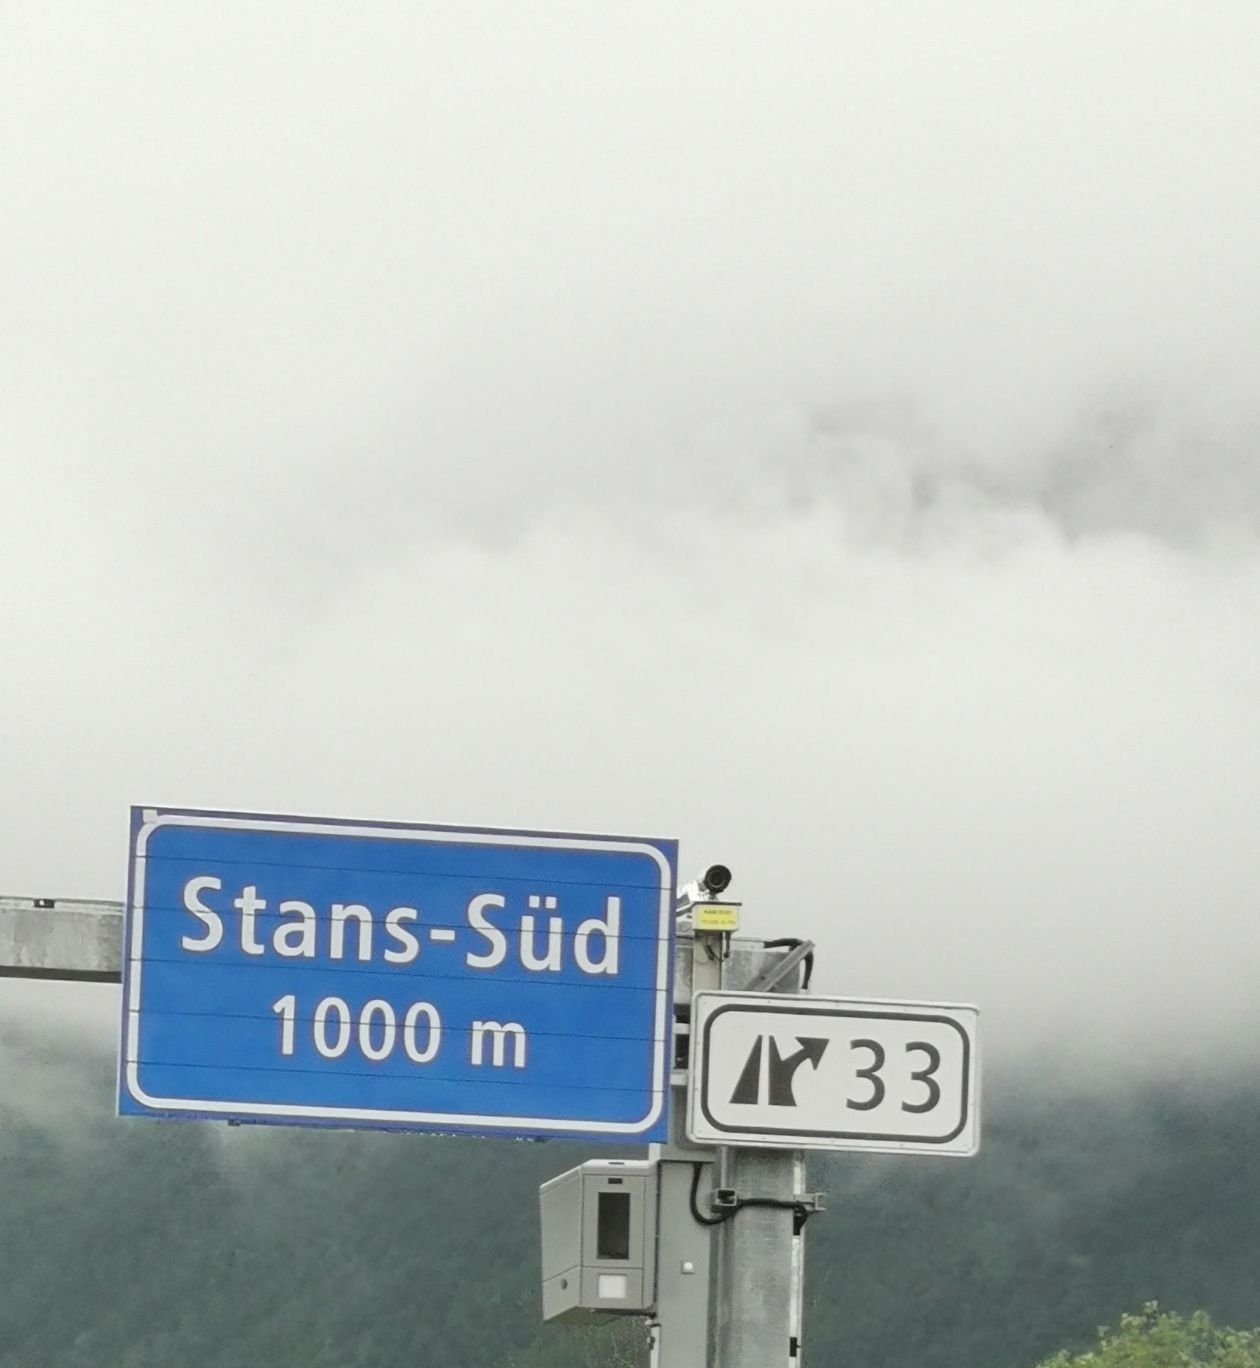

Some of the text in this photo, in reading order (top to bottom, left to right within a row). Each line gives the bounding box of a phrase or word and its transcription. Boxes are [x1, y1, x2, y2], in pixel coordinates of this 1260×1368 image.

[181, 874, 622, 976] Stans-Süd
[271, 994, 527, 1069] 1000 m
[845, 1038, 941, 1114] 33
